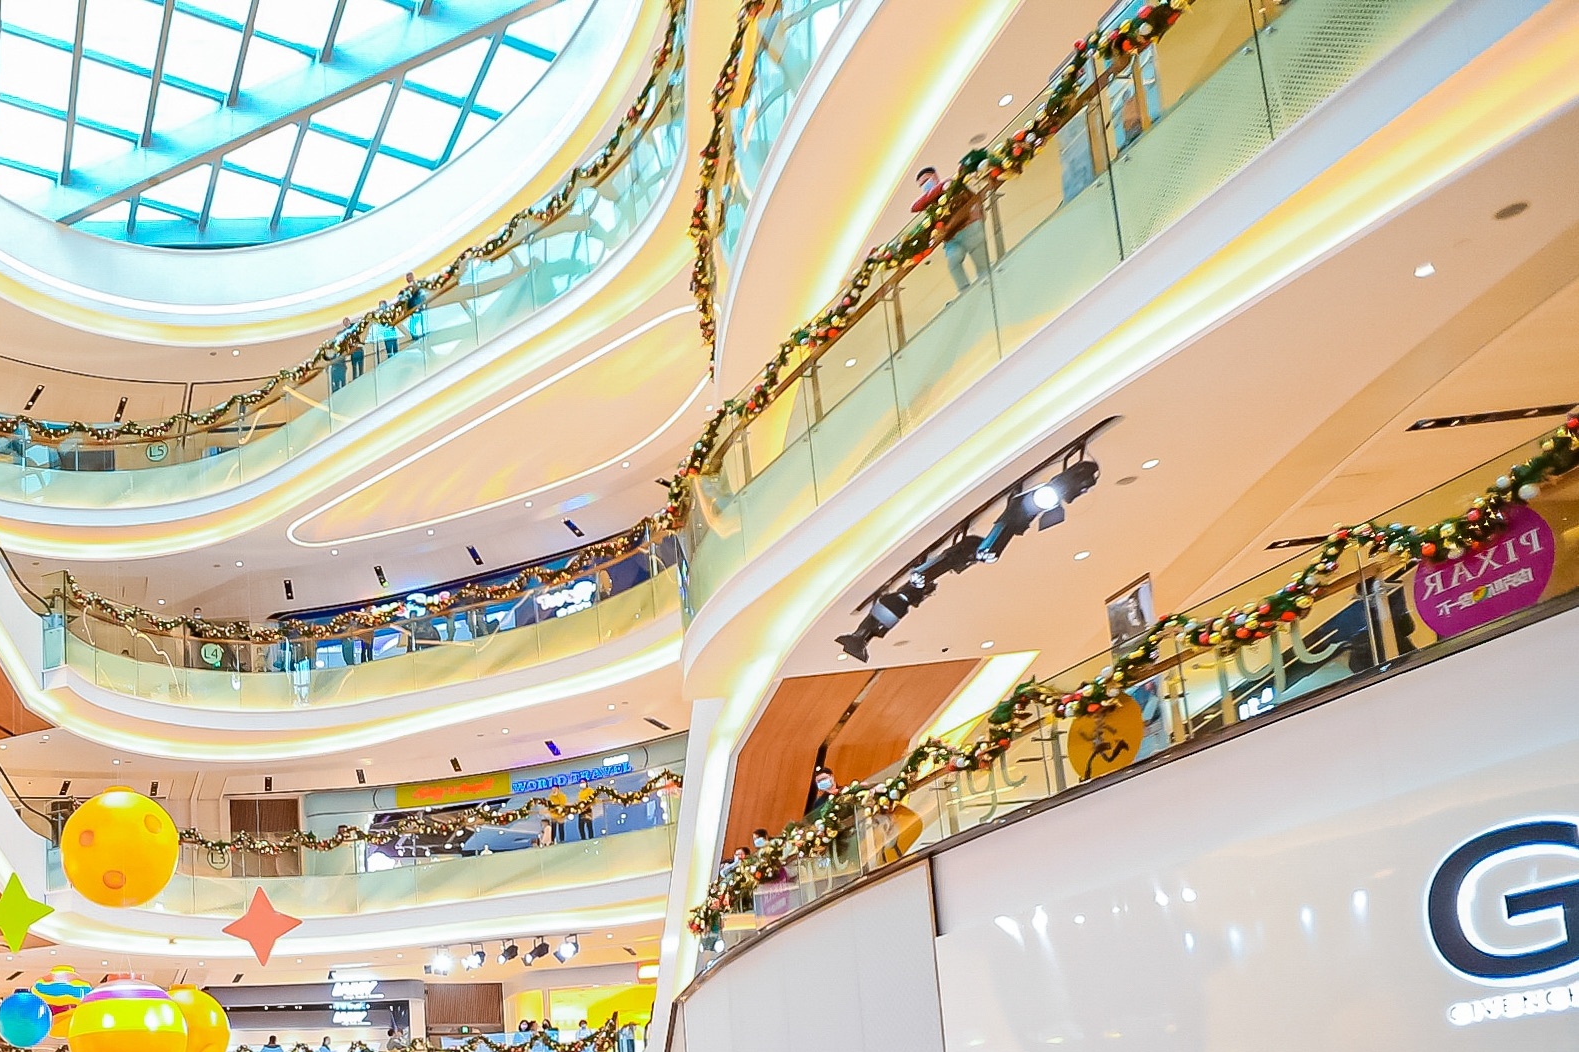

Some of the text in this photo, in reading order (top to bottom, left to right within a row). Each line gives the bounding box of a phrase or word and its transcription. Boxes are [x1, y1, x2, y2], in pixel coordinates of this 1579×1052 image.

[149, 445, 164, 457] L5
[204, 648, 218, 659] L4
[512, 775, 570, 793] WORLD
[572, 762, 632, 783] TRAVEL
